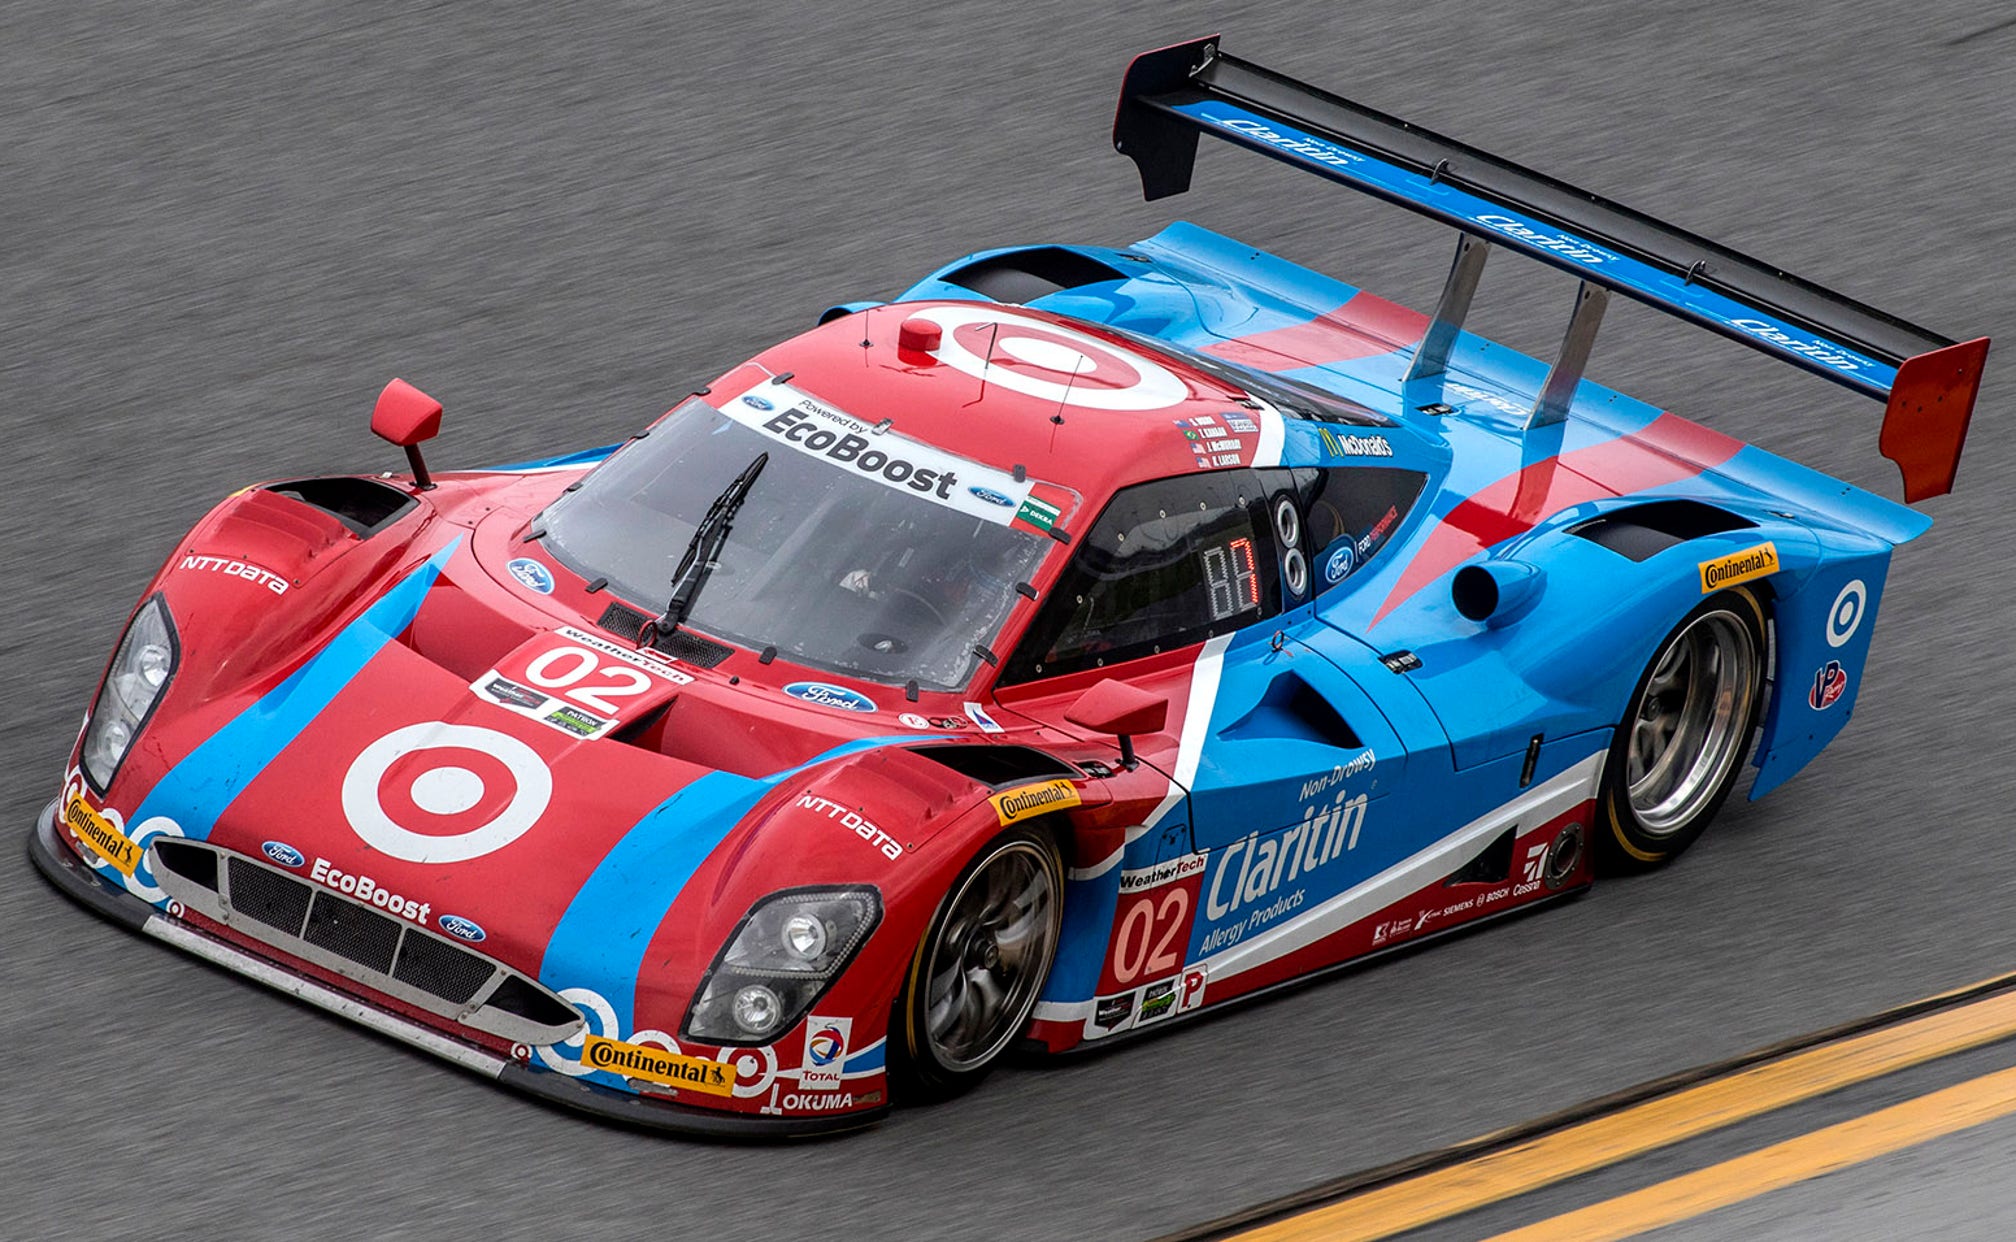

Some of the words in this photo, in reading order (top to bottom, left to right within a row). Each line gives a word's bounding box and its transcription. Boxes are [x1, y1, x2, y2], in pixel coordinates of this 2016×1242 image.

[1221, 119, 1348, 166] Claritin
[1476, 214, 1603, 264] Claritin
[1730, 318, 1858, 371] Claritin
[799, 399, 852, 426] Powered
[849, 421, 868, 434] by
[762, 407, 959, 500] EcoBoost
[1338, 434, 1393, 457] McDonald's
[510, 562, 547, 589] Ford
[1330, 551, 1350, 580] Ford
[1705, 549, 1765, 589] Continental
[565, 629, 685, 682] WeatherTech
[525, 646, 652, 715] 02
[801, 685, 860, 709] Ford
[1298, 748, 1376, 802] Non-Drowsy
[998, 784, 1067, 820] Continental
[67, 798, 125, 859] Continental
[268, 844, 295, 865] Ford
[1120, 855, 1205, 889] WeatherTech
[1206, 789, 1368, 921] Claritin
[309, 857, 432, 925] EcoBoost
[446, 919, 478, 940] Ford
[1113, 887, 1189, 984] 02
[1199, 917, 1248, 956] Allergy
[1250, 887, 1306, 931] Products
[589, 1040, 708, 1084] Continental
[803, 1070, 840, 1081] TOTAL
[782, 1092, 853, 1111] OKUMA
